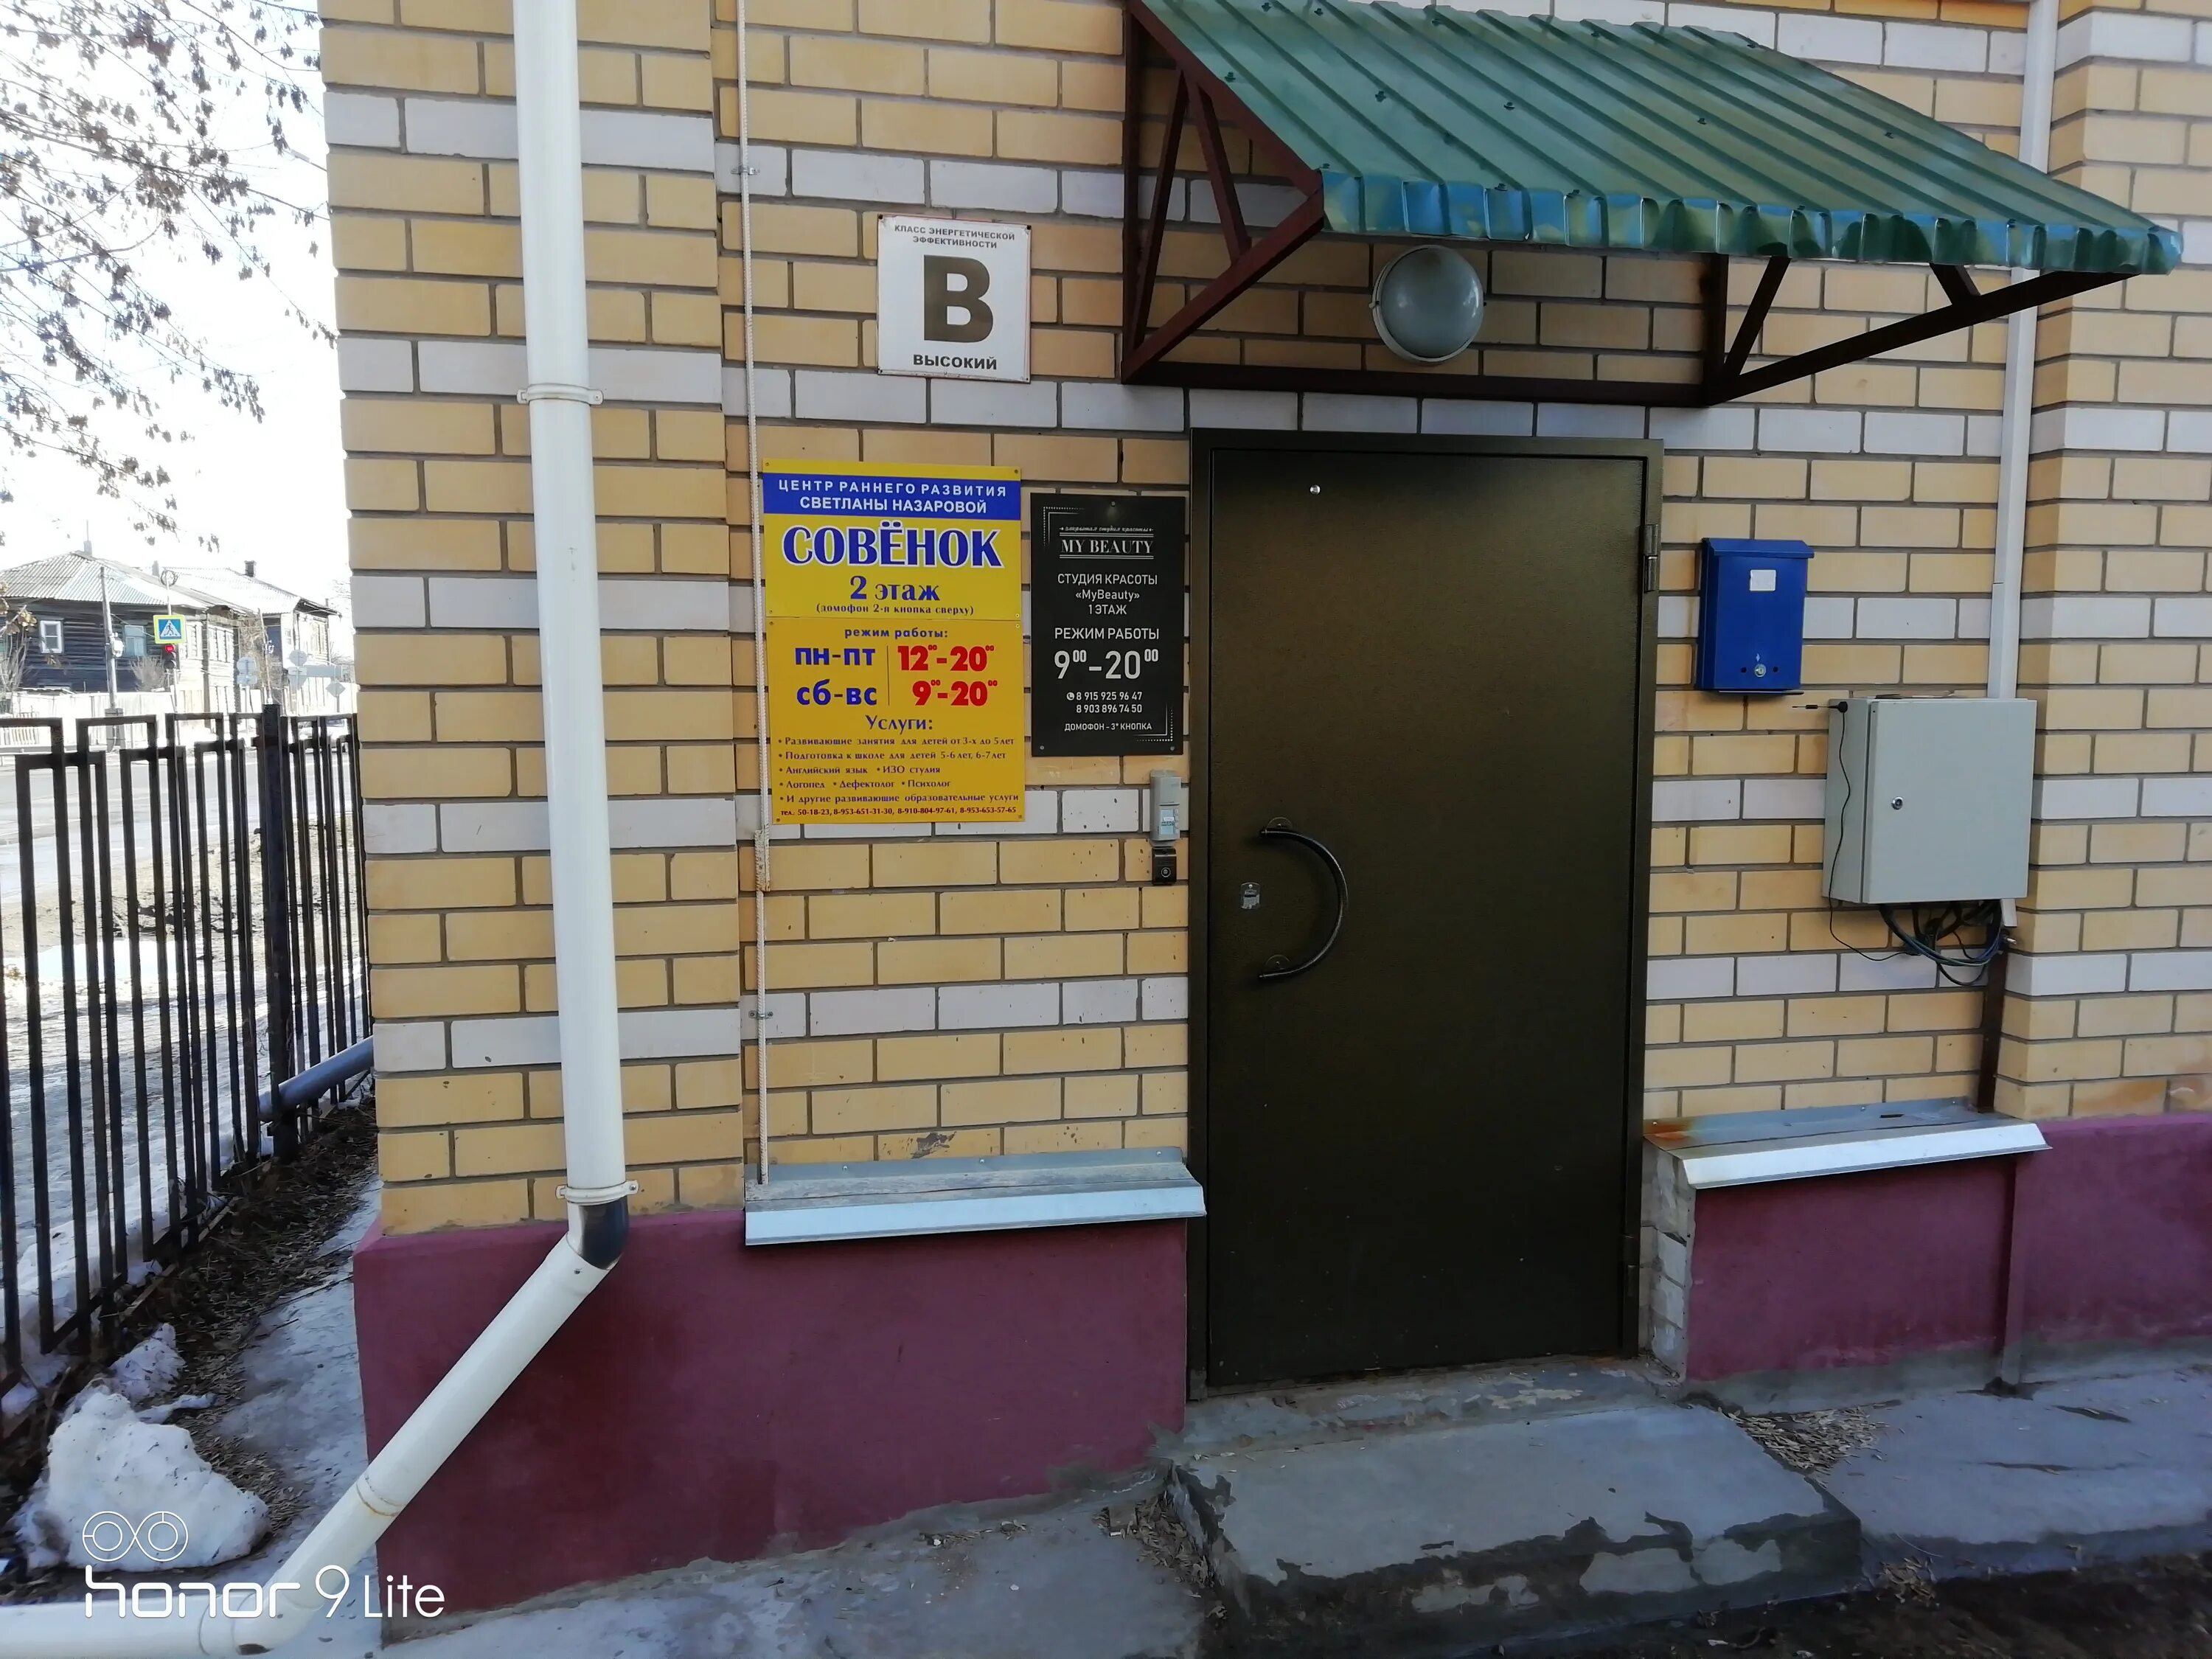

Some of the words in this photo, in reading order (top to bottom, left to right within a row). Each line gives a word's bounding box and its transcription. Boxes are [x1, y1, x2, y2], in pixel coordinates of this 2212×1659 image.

[894, 224, 926, 234] КЛАСС
[929, 227, 1015, 240] ЭНЕРГЕТИЧЕСКОЙ
[913, 235, 998, 248] ЭФФЕКТИВНОСТИ
[914, 354, 997, 370] ВЫСОКИЙ
[779, 479, 834, 493] ЦЕНТР
[840, 482, 916, 495] РАННЕГО
[921, 484, 1006, 497] РАЗВИТИЯ
[800, 496, 888, 511] СВЕТЛАНЫ
[892, 498, 987, 514] НАЗАРОВОЙ
[782, 519, 1005, 568] СОВЁНОК
[1062, 539, 1085, 553] MY
[1090, 539, 1153, 554] BEAUTY
[1057, 573, 1103, 586] СТУДИЯ
[1105, 574, 1158, 585] КРАСОТЫ
[849, 575, 867, 600] 2
[874, 583, 940, 602] этаж
[1075, 589, 1140, 602] «MyBeauty»
[816, 603, 869, 613] (домофон
[873, 604, 890, 613] 2-я
[935, 605, 974, 616] сверху)
[1094, 604, 1127, 615] ЭТАЖ
[845, 628, 889, 639] режим
[894, 627, 948, 639] работы:
[1054, 627, 1105, 640] РЕЖИМ
[1107, 627, 1160, 640] РАБОТЫ
[795, 647, 876, 666] пн-пт
[796, 678, 877, 706] сб-вс
[1076, 692, 1082, 700] 8
[1084, 692, 1099, 700] 915
[1101, 692, 1117, 700] 925
[1119, 692, 1130, 700] 96
[1131, 692, 1143, 700] 47
[1076, 704, 1082, 713] 8
[1083, 704, 1099, 713] 903
[1102, 704, 1118, 713] 896
[1119, 704, 1130, 713] 74
[1131, 704, 1143, 713] 50
[865, 714, 933, 735] Услуги:
[1064, 723, 1105, 731] ДОМОФОН
[1120, 723, 1152, 731] КНОПКА
[785, 737, 852, 745] Развивающие
[922, 737, 948, 745] детей
[962, 737, 977, 745] 3-х
[785, 751, 843, 760] Подготовка
[910, 751, 936, 759] детей
[940, 751, 956, 759] 5-6
[975, 751, 991, 759] 6-7
[785, 766, 841, 774] Английский
[883, 765, 905, 773] ИЗО
[909, 767, 941, 776] студия
[786, 781, 825, 789] Логопед
[839, 779, 895, 790] Дефектолог
[908, 779, 951, 787] Психолог
[787, 795, 794, 803] И
[799, 796, 832, 805] другие
[835, 795, 900, 804] развивающие
[905, 793, 986, 804] образовательные
[990, 794, 1019, 803] услуги
